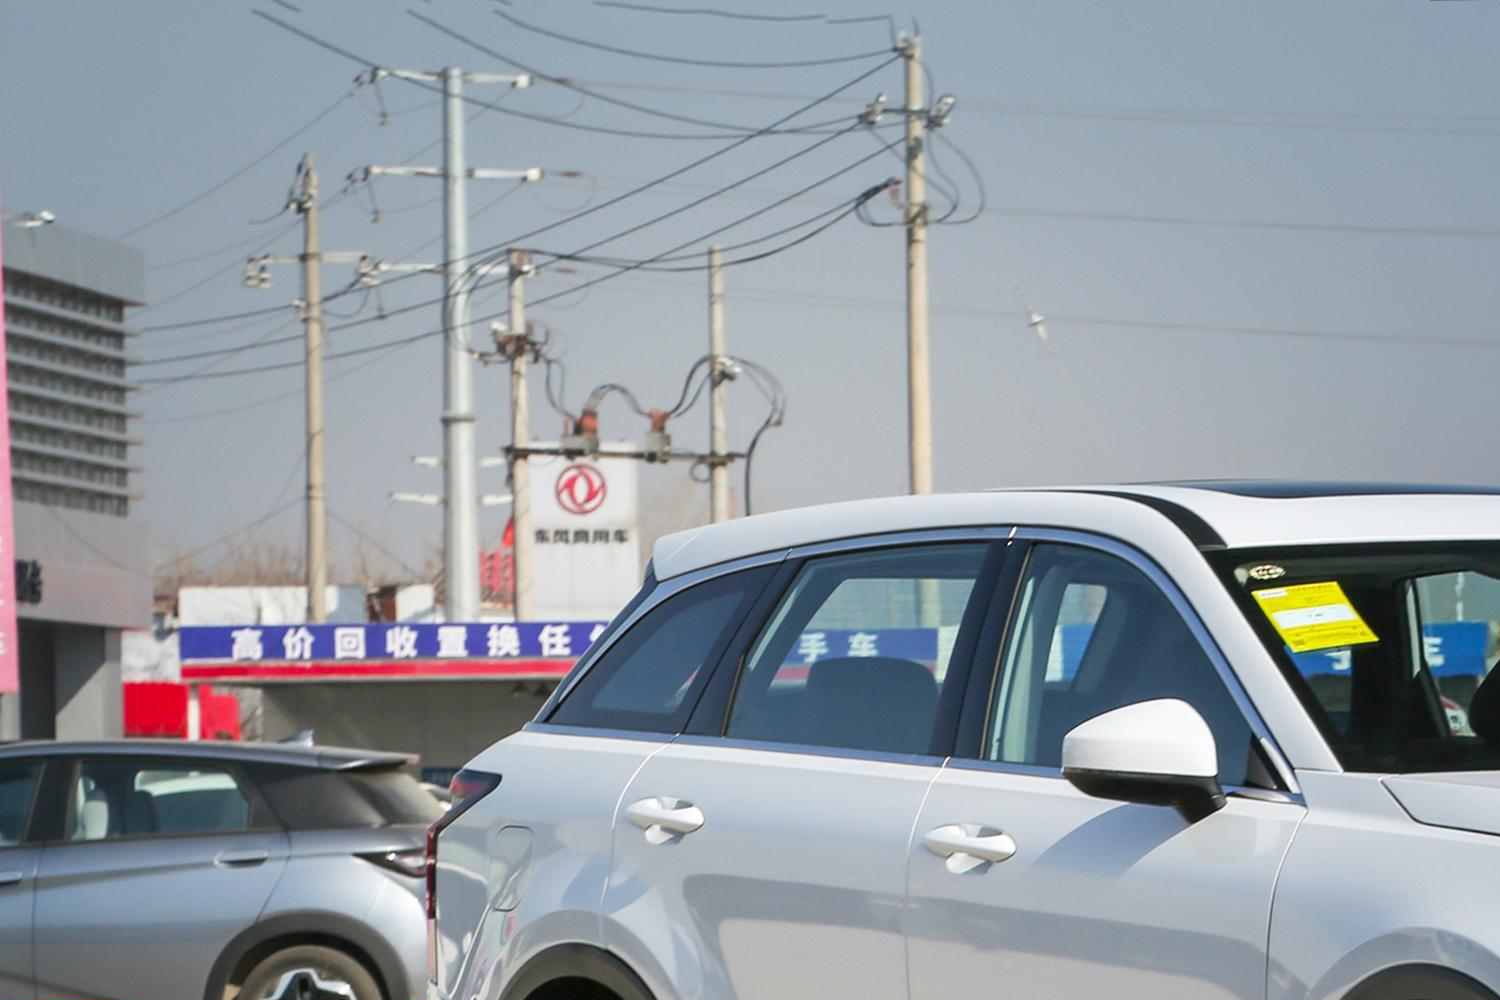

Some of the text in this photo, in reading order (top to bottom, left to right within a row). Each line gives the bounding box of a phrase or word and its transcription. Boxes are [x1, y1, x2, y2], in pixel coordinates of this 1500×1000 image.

[535, 529, 629, 543] 东风商用车
[231, 624, 608, 661] 高价回收置换任
